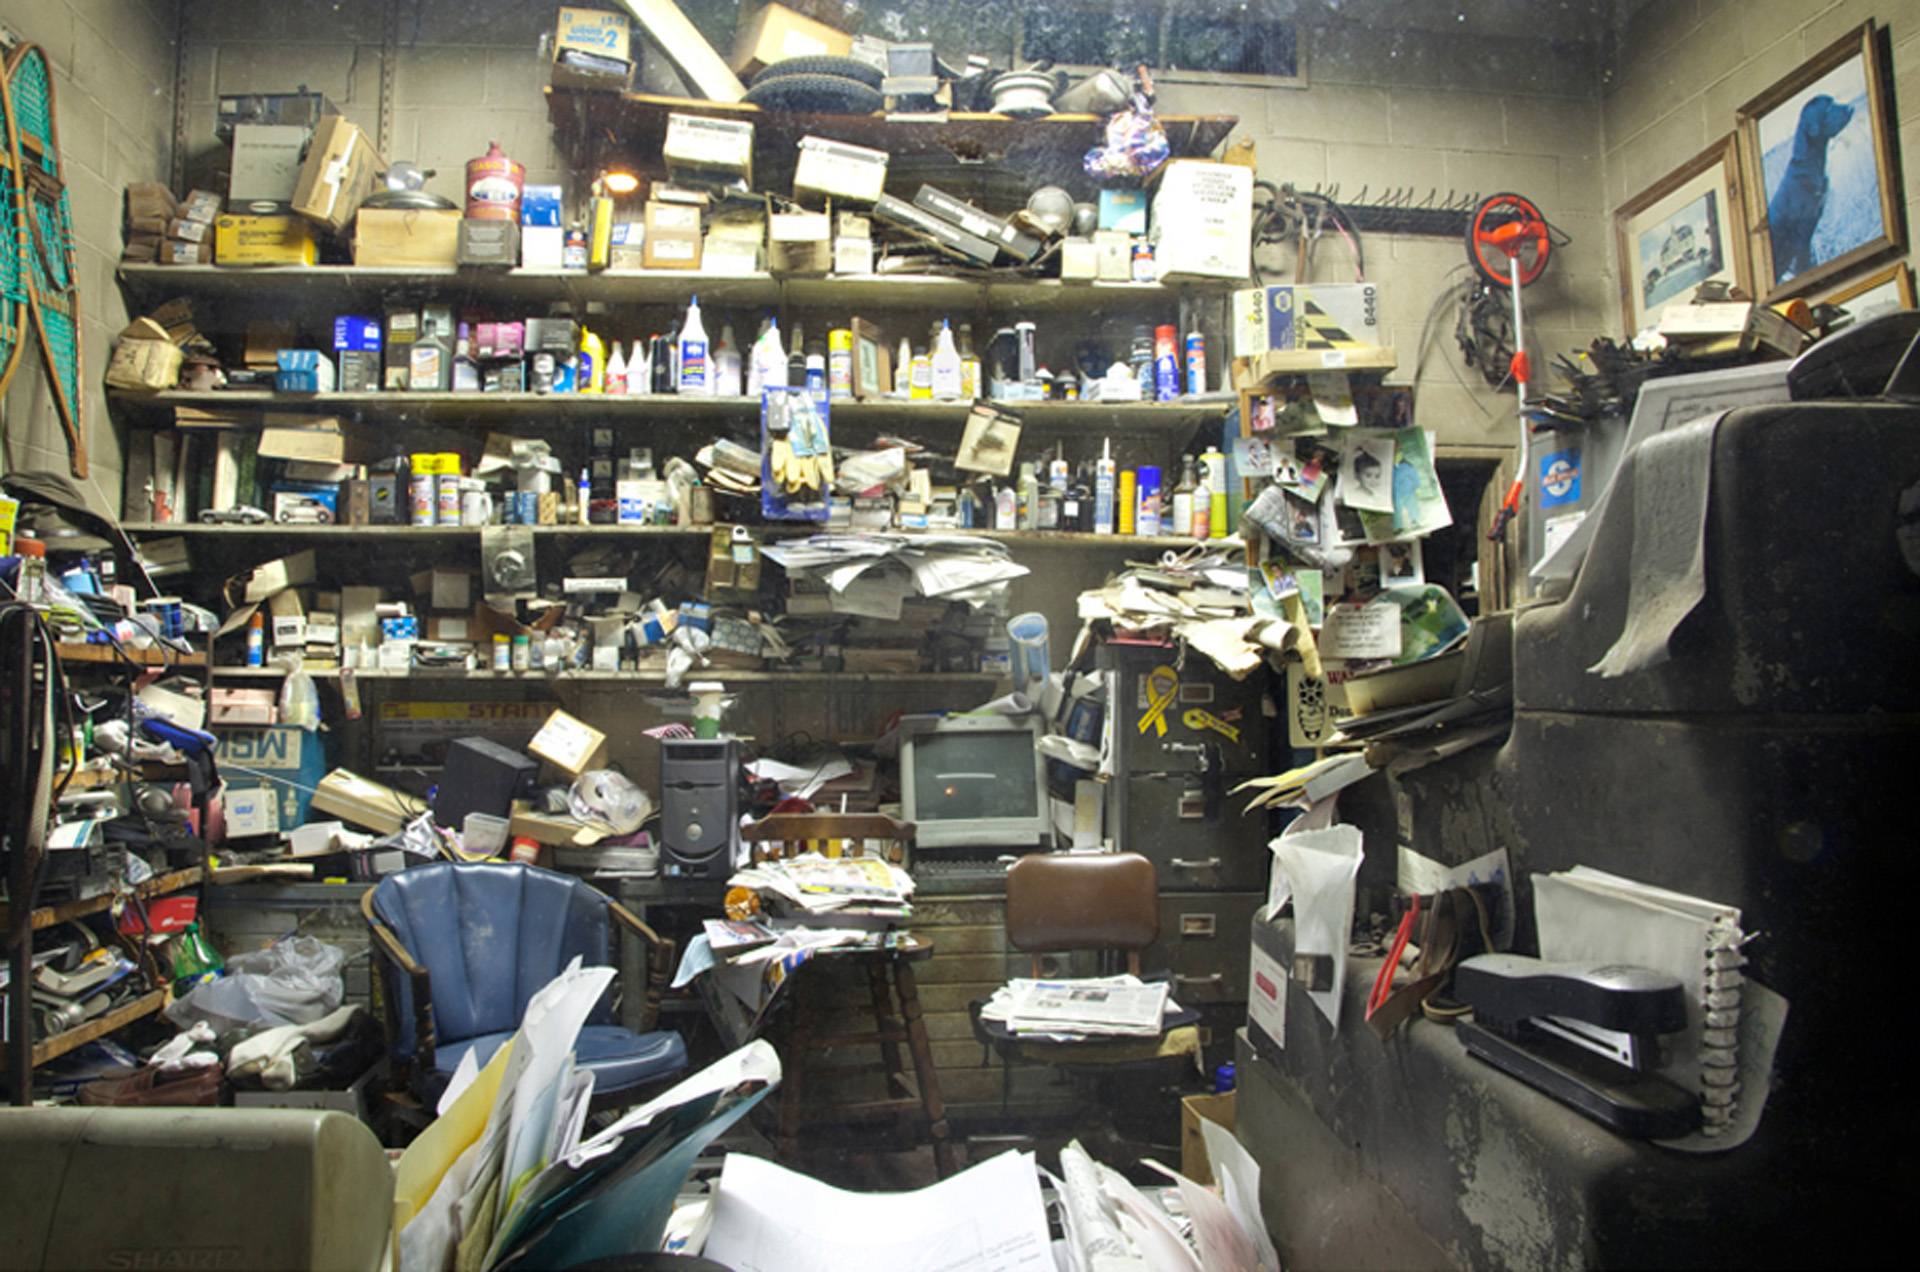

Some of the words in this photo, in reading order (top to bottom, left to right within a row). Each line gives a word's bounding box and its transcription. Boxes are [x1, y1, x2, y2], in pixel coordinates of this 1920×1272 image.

[605, 30, 618, 48] 2
[1363, 286, 1376, 326] 6440
[106, 1248, 241, 1270] SHARP
